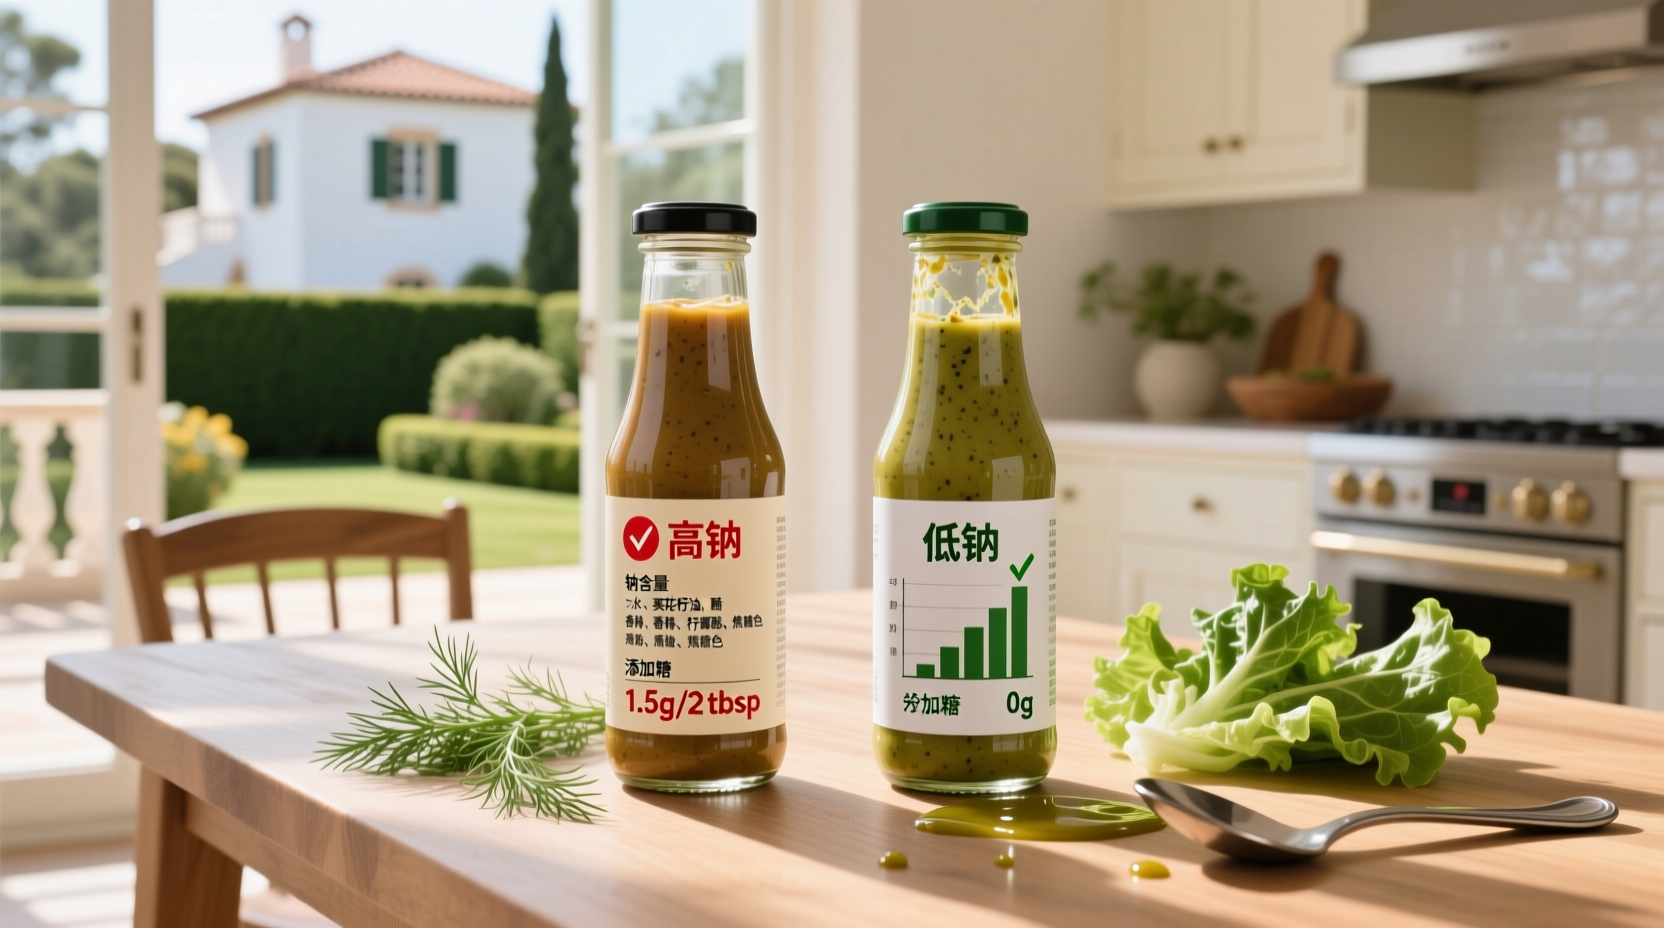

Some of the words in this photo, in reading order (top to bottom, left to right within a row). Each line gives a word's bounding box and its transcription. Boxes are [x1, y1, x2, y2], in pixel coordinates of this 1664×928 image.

[668, 520, 741, 560] 高钠
[923, 522, 999, 562] 低钠
[1007, 691, 1033, 719] 0g
